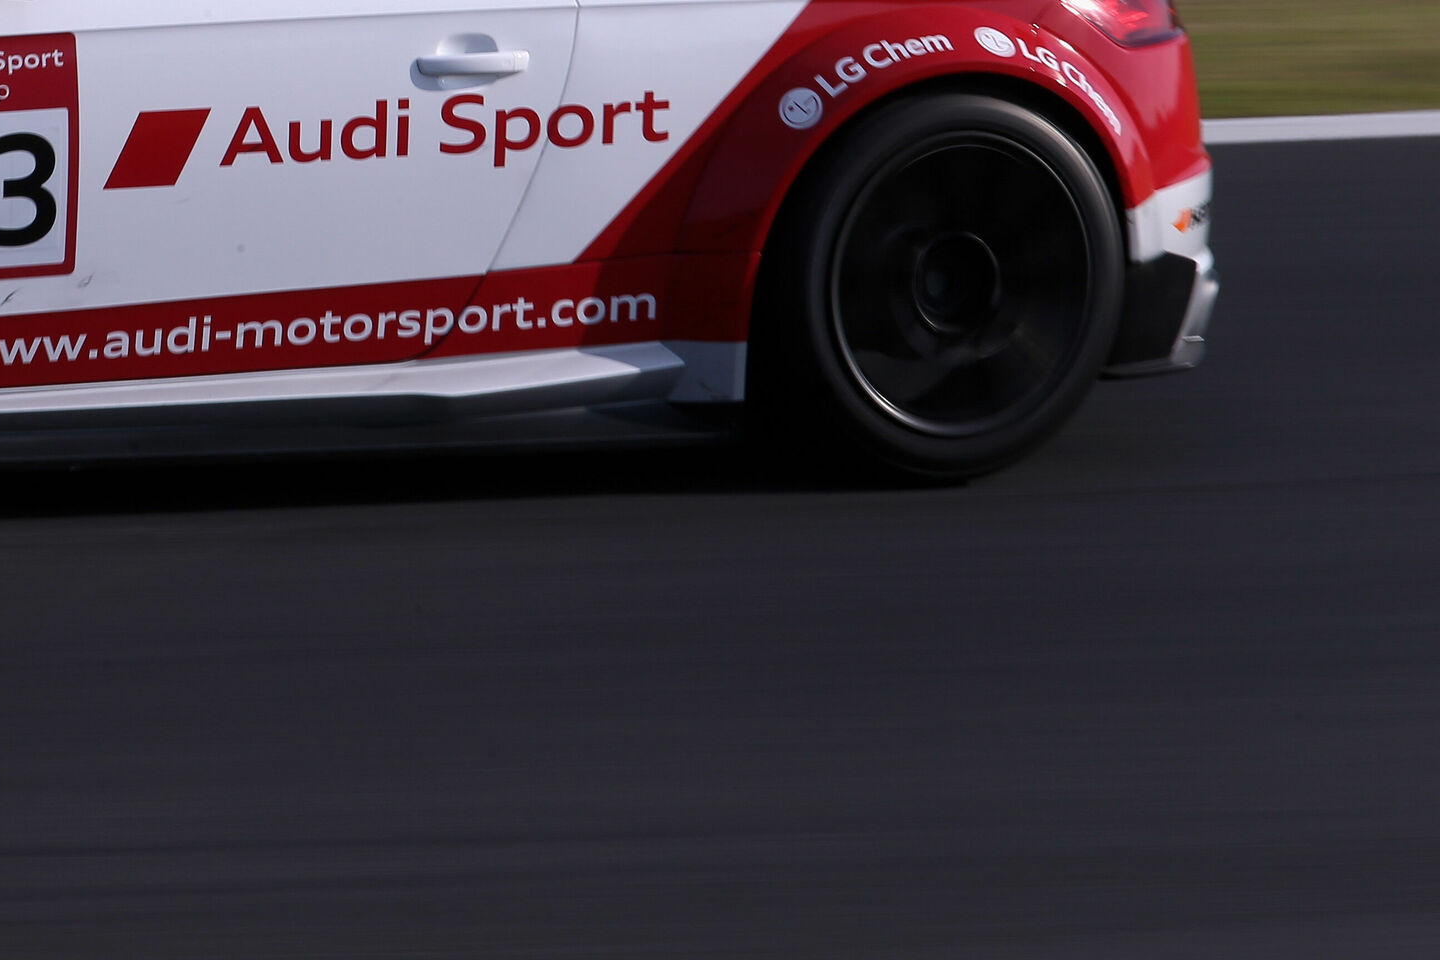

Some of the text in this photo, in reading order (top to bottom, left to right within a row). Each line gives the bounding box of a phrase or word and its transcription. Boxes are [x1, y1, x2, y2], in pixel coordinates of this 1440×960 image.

[813, 33, 954, 98] LG Chem
[1014, 38, 1122, 137] LG Chem
[219, 90, 670, 167] Audi Sport
